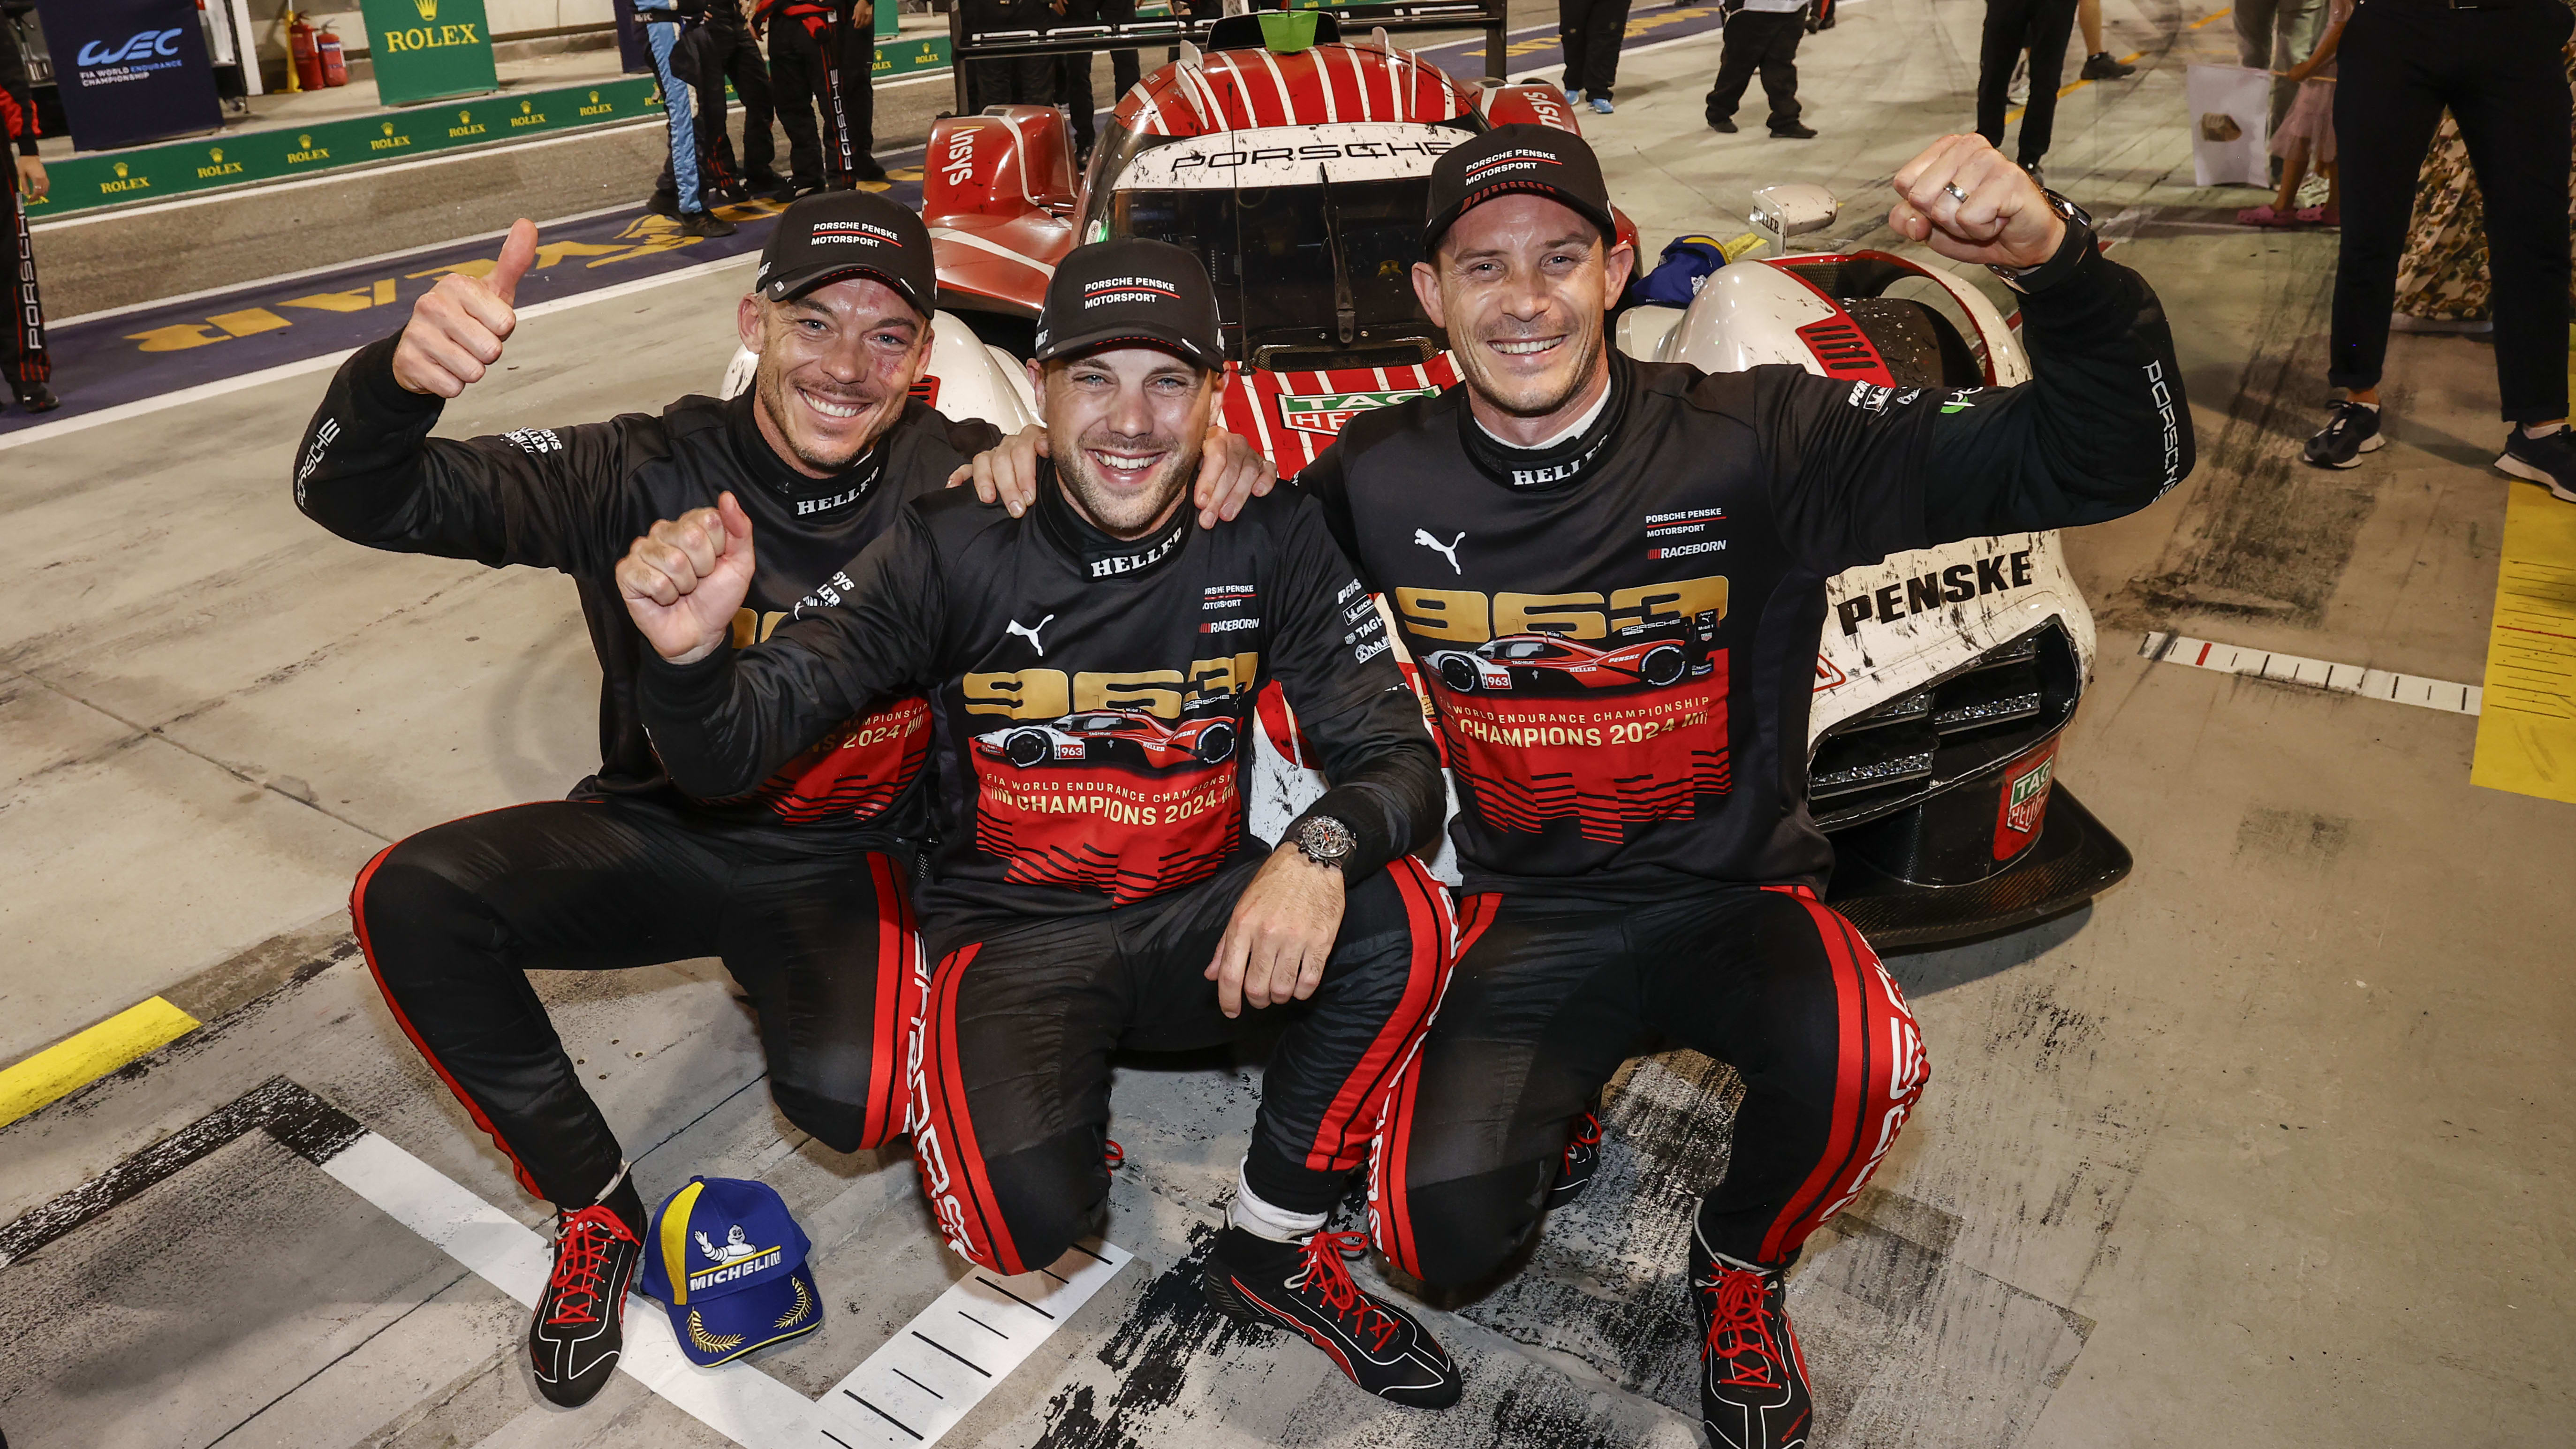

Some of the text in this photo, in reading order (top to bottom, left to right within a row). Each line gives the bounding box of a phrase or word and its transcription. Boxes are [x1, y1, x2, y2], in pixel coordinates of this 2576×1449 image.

[77, 28, 183, 67] WEC
[385, 23, 480, 53] ROLEX
[916, 53, 939, 64] ROLEX
[96, 67, 130, 78] WORLD
[130, 59, 182, 73] ENDURANCE
[82, 71, 150, 87] CHAMPIONSHIP
[579, 103, 613, 116] ROLEX
[1523, 91, 1565, 130] nsys
[510, 114, 546, 127] ROLEX
[830, 69, 853, 170] PORSCHE
[449, 123, 486, 137] ROLEX
[371, 135, 411, 150] ROLEX
[287, 148, 330, 164] ROLEX
[1171, 142, 1452, 172] PORSCHE
[1466, 149, 1556, 173] PORSCHE PENSKE
[197, 162, 243, 179] ROLEX
[1466, 162, 1537, 186] MOTORSPORT
[100, 177, 151, 194] ROLEX
[813, 221, 898, 241] PORSCHE PENSKE
[811, 235, 880, 248] MOTORSPORT
[15, 190, 42, 349] PORSCHE
[1085, 277, 1175, 292] PORSCHE PENSKE
[1085, 293, 1157, 310] MOTORSPORT
[1848, 380, 1871, 407] PEN
[2142, 360, 2179, 503] PORSCHE
[1646, 508, 1722, 523] PORSCHE PENSKE
[1647, 524, 1705, 538] MOTORSPORT
[1661, 540, 1727, 559] RACEBORN
[833, 571, 855, 591] sys
[817, 584, 841, 606] LER
[1338, 578, 1362, 605] PENS
[1837, 550, 2032, 636] PENSKE
[1202, 599, 1242, 610] OTORSPORT
[1395, 575, 1729, 643] 963
[1211, 618, 1259, 633] RACEBORN
[1622, 619, 1681, 633] PORSCHE
[1608, 653, 1640, 663] PENSKE
[962, 652, 1258, 720] 963
[1488, 676, 1509, 686] 963
[1183, 694, 1230, 707] PORSCHE
[844, 703, 928, 727] HAMPIONSHIP
[1454, 697, 1709, 724] WORLD ENDURANCE CHAMPIONSHIP
[843, 724, 900, 749] 2024
[1173, 729, 1197, 741] PENSKE
[1460, 718, 1675, 748] CHAMPIONS 2024
[1061, 747, 1083, 756] 963
[1143, 742, 1166, 752] HELLER
[987, 774, 1230, 803] FIA WORLD ENDURANCE CHAMPIONS
[2017, 761, 2051, 799] TAG
[1016, 790, 1216, 826] CHAMPIONS 2024
[689, 1251, 781, 1291] MICHELIN
